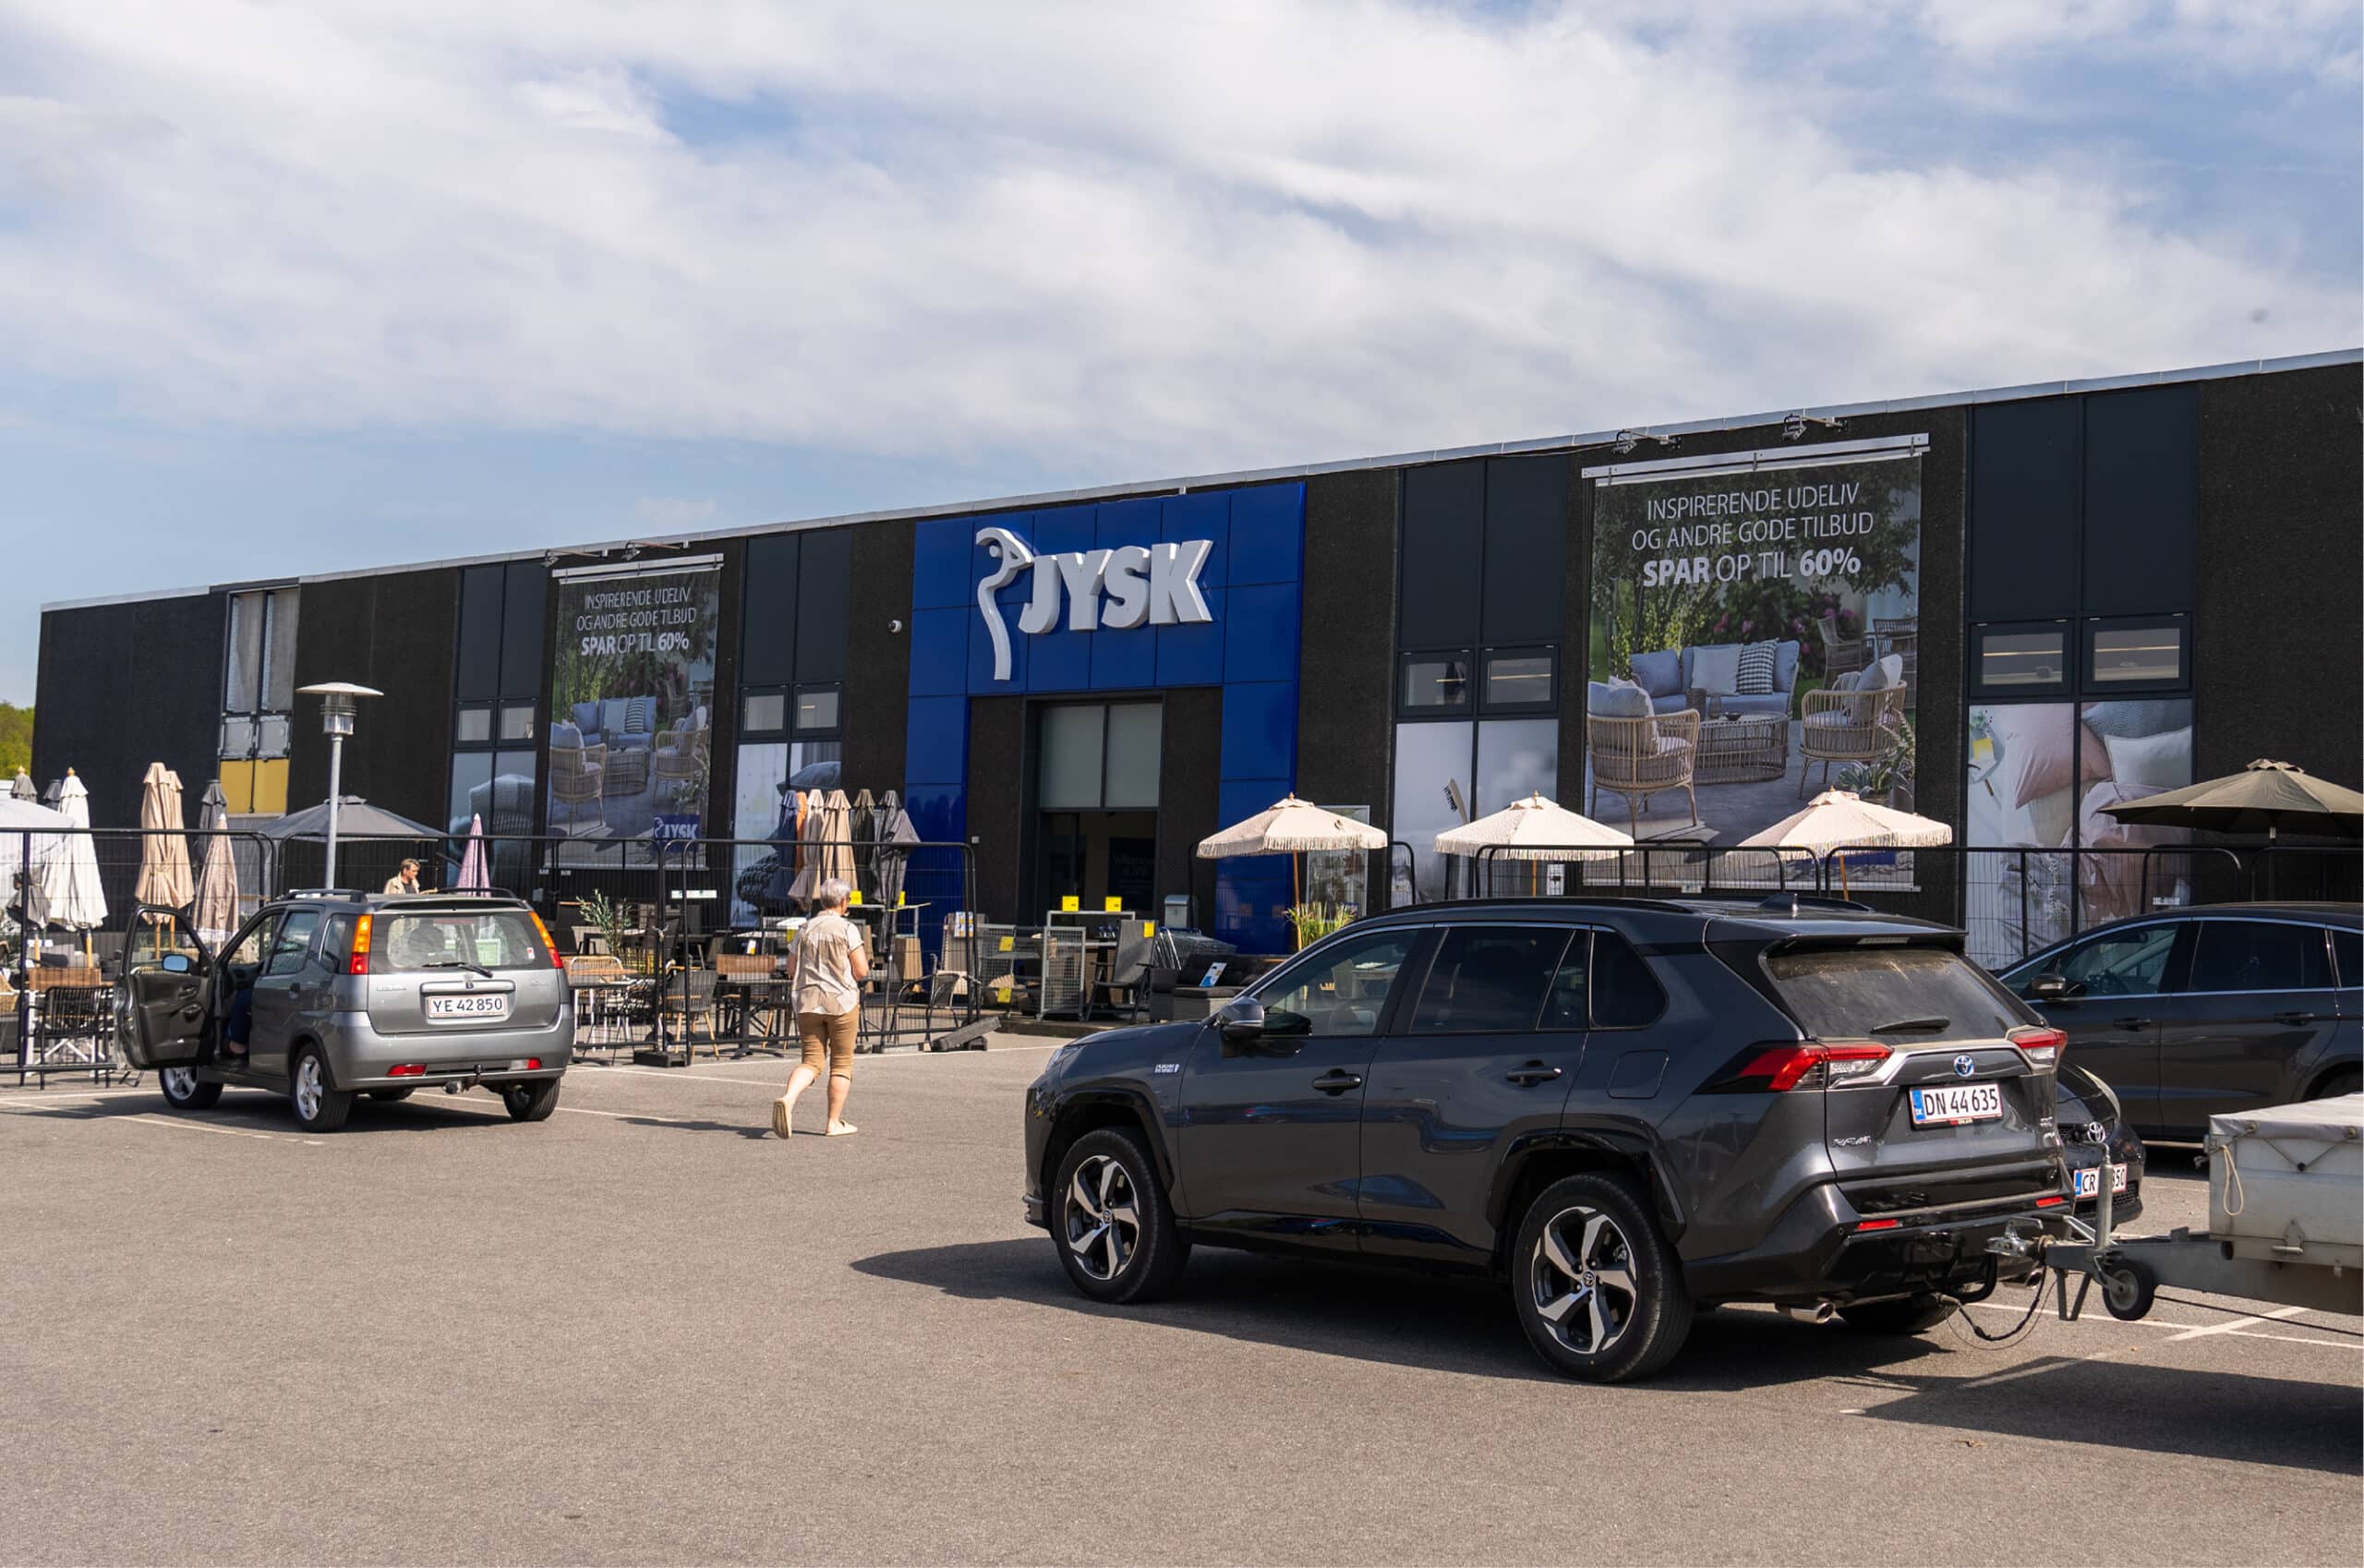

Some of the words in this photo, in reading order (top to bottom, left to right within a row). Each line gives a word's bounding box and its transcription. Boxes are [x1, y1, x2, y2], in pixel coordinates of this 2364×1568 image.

[1647, 489, 1781, 520] INSPIRERENDE
[1788, 483, 1860, 509] UDELIV
[1633, 528, 1661, 550] OG
[1667, 523, 1732, 548] ANDRE
[1739, 518, 1796, 543] GODE
[1801, 512, 1874, 537] TILBUD
[1643, 557, 1708, 587] SPAR
[1716, 554, 1751, 582] OP
[1758, 551, 1792, 579] TIL
[1800, 547, 1862, 577] 60%
[585, 589, 652, 610] INSPIRERENDE
[655, 586, 692, 604] UDELIV
[1019, 539, 1213, 634] JYSK
[576, 615, 592, 632] OG
[594, 612, 627, 630] ANDRE
[630, 609, 658, 627] GODE
[581, 634, 615, 657] SPAR
[617, 633, 636, 654] OP
[657, 631, 689, 652] 60%
[663, 824, 698, 839] JYSK
[433, 999, 453, 1013] YE
[456, 999, 474, 1012] 42
[476, 997, 503, 1011] 850
[1924, 1092, 1947, 1116] DN
[1950, 1091, 1969, 1114] 44
[1972, 1089, 1998, 1112] 635
[2082, 1174, 2096, 1192] CR
